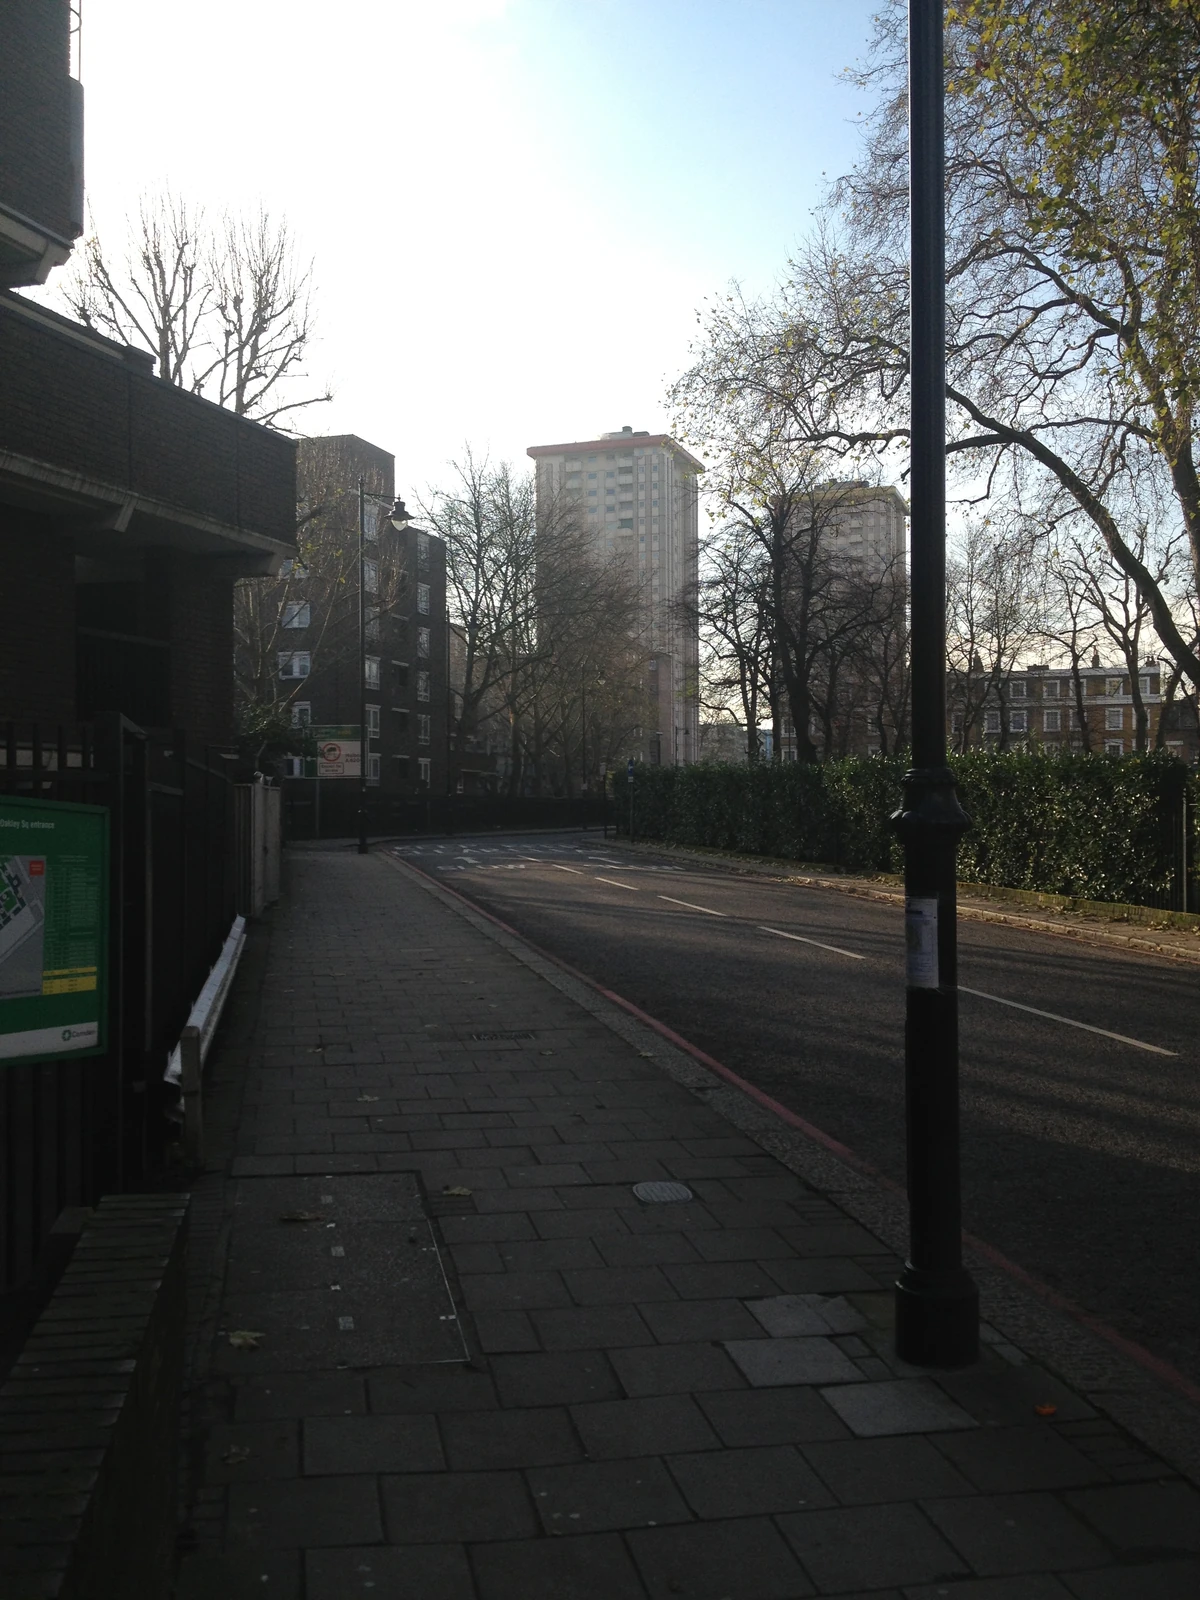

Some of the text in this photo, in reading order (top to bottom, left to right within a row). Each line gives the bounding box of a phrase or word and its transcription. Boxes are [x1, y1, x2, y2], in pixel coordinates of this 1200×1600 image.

[0, 818, 55, 829] Oakley Sq entrance
[71, 1029, 96, 1038] Camden
